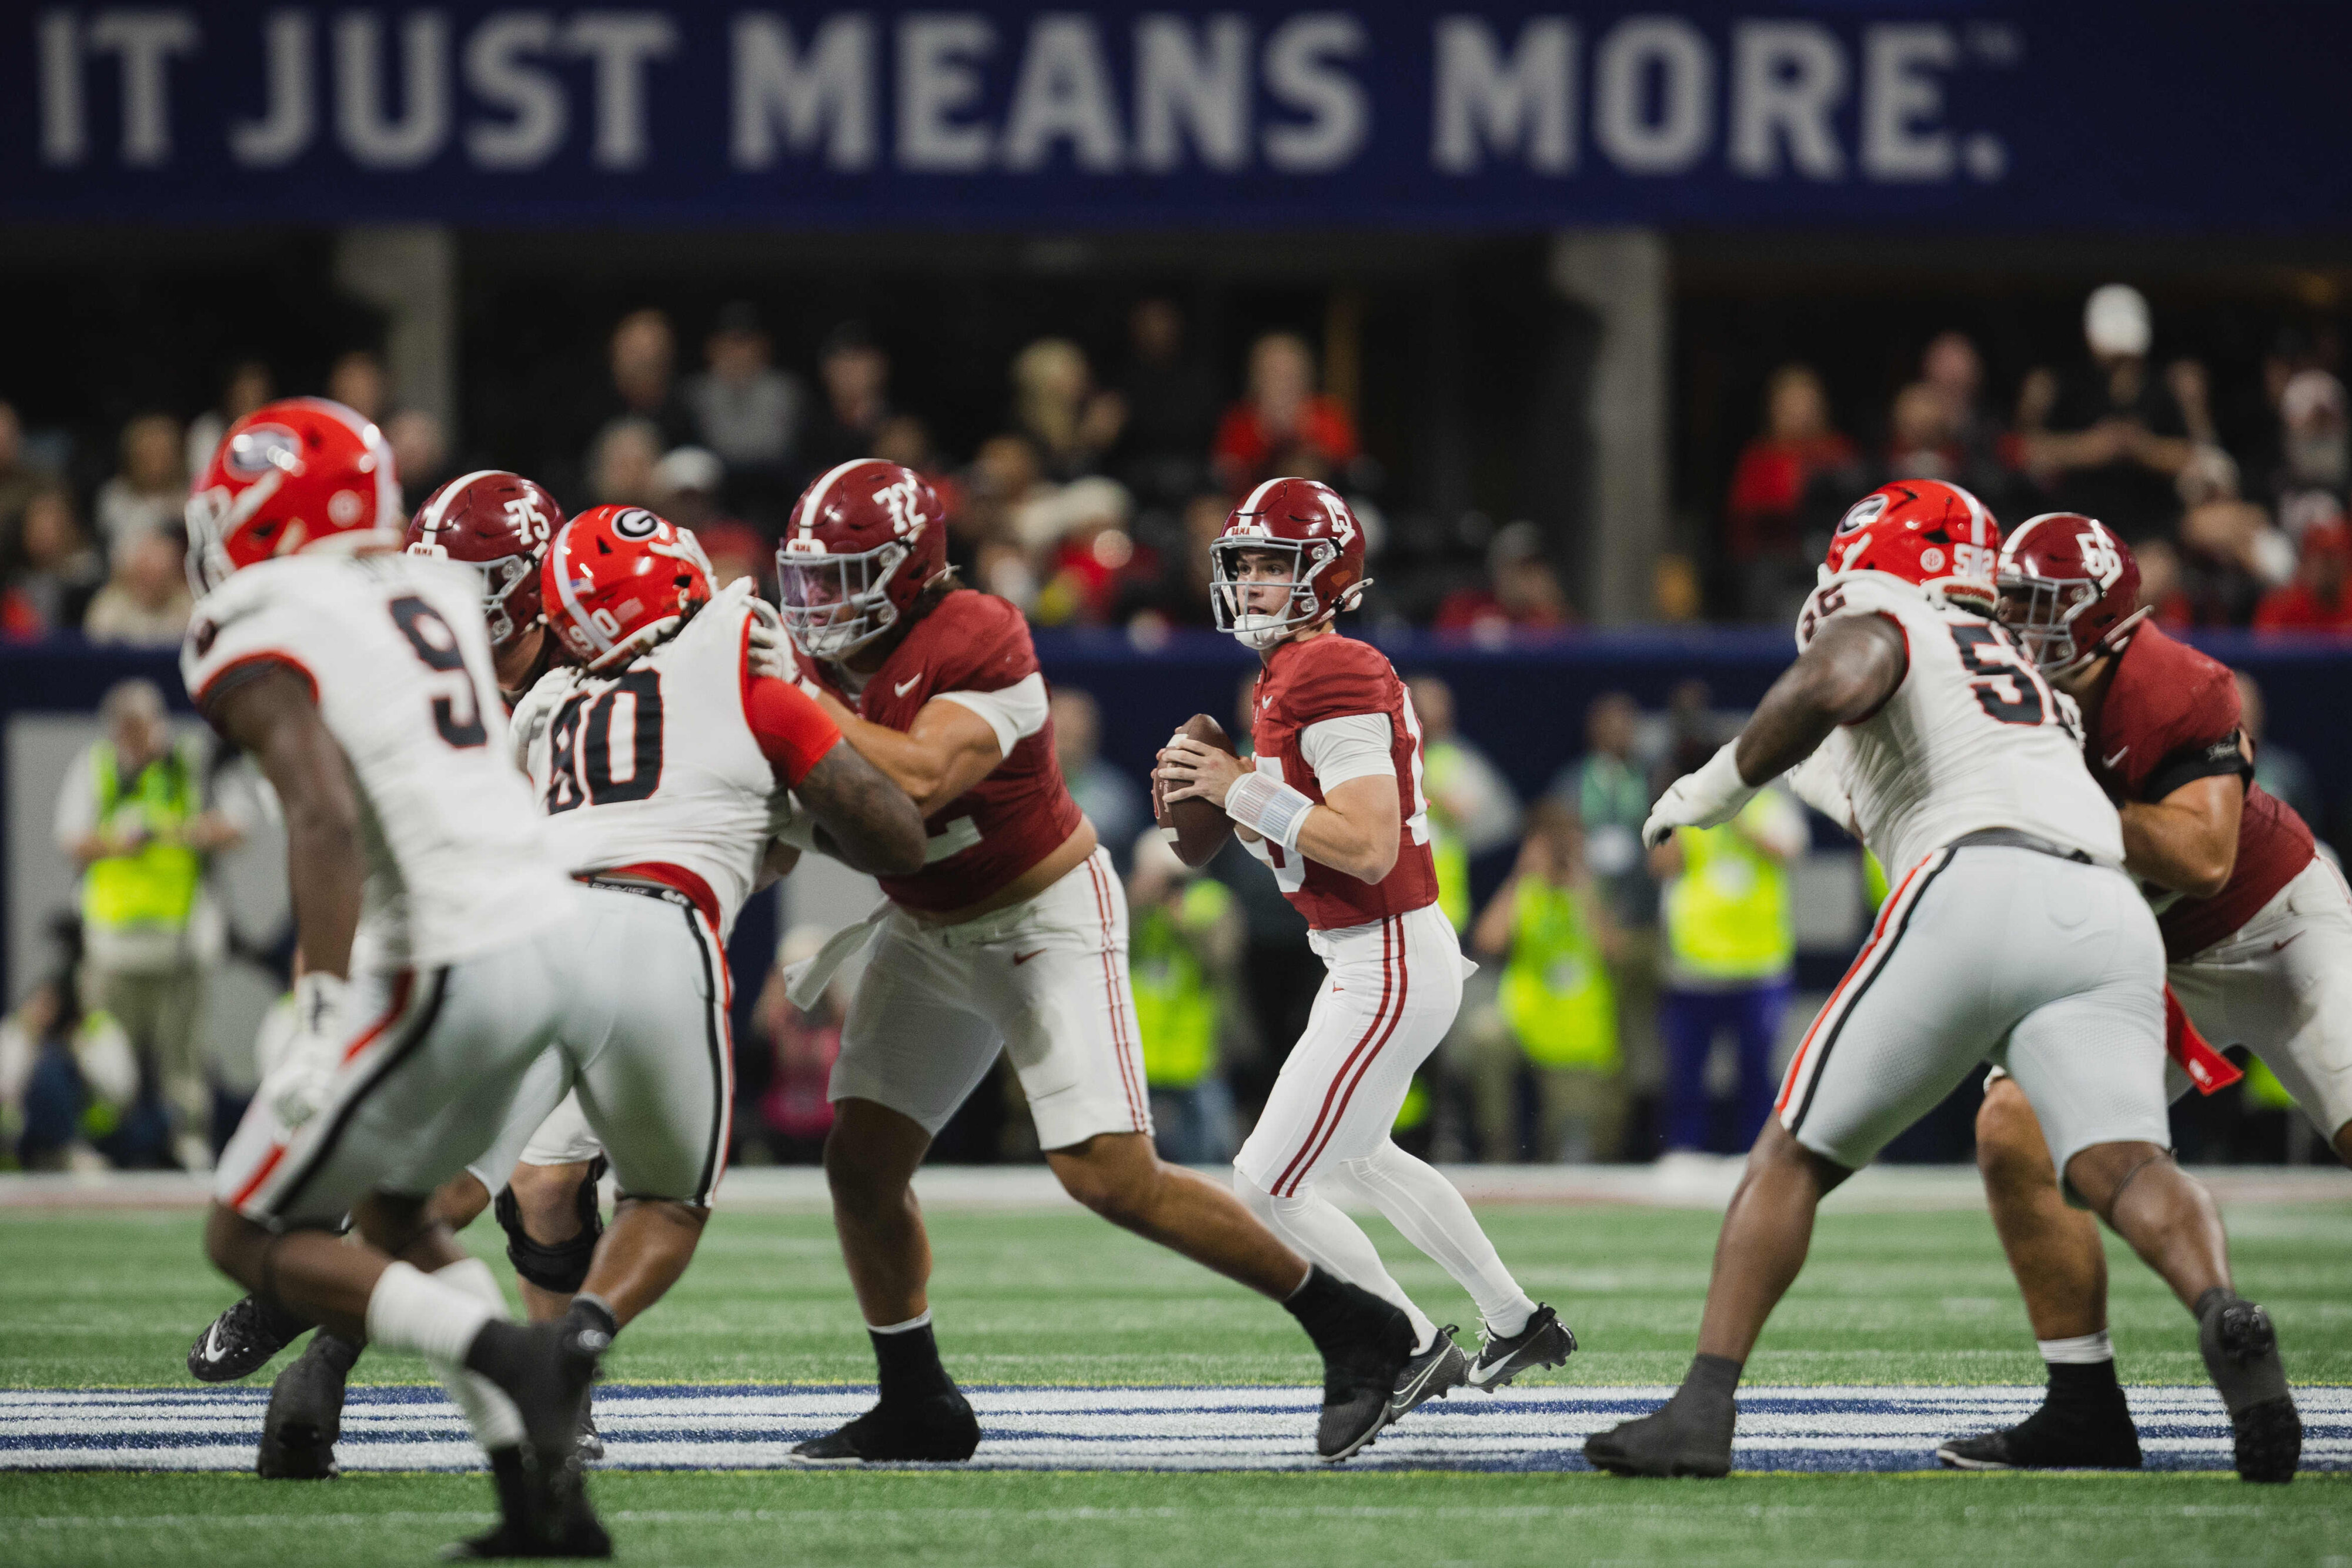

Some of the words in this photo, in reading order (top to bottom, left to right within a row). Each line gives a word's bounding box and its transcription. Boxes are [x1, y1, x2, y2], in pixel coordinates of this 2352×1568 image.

[36, 11, 200, 167] IT
[229, 9, 679, 169] JUST
[729, 11, 1370, 174] MEANS
[1432, 13, 2006, 181] MORE.
[503, 497, 550, 546] 75
[617, 510, 657, 537] G
[872, 482, 927, 534] 72
[1317, 494, 1352, 533] 15
[1952, 543, 1996, 582] 52
[569, 608, 621, 651] 90
[387, 595, 489, 749] 9
